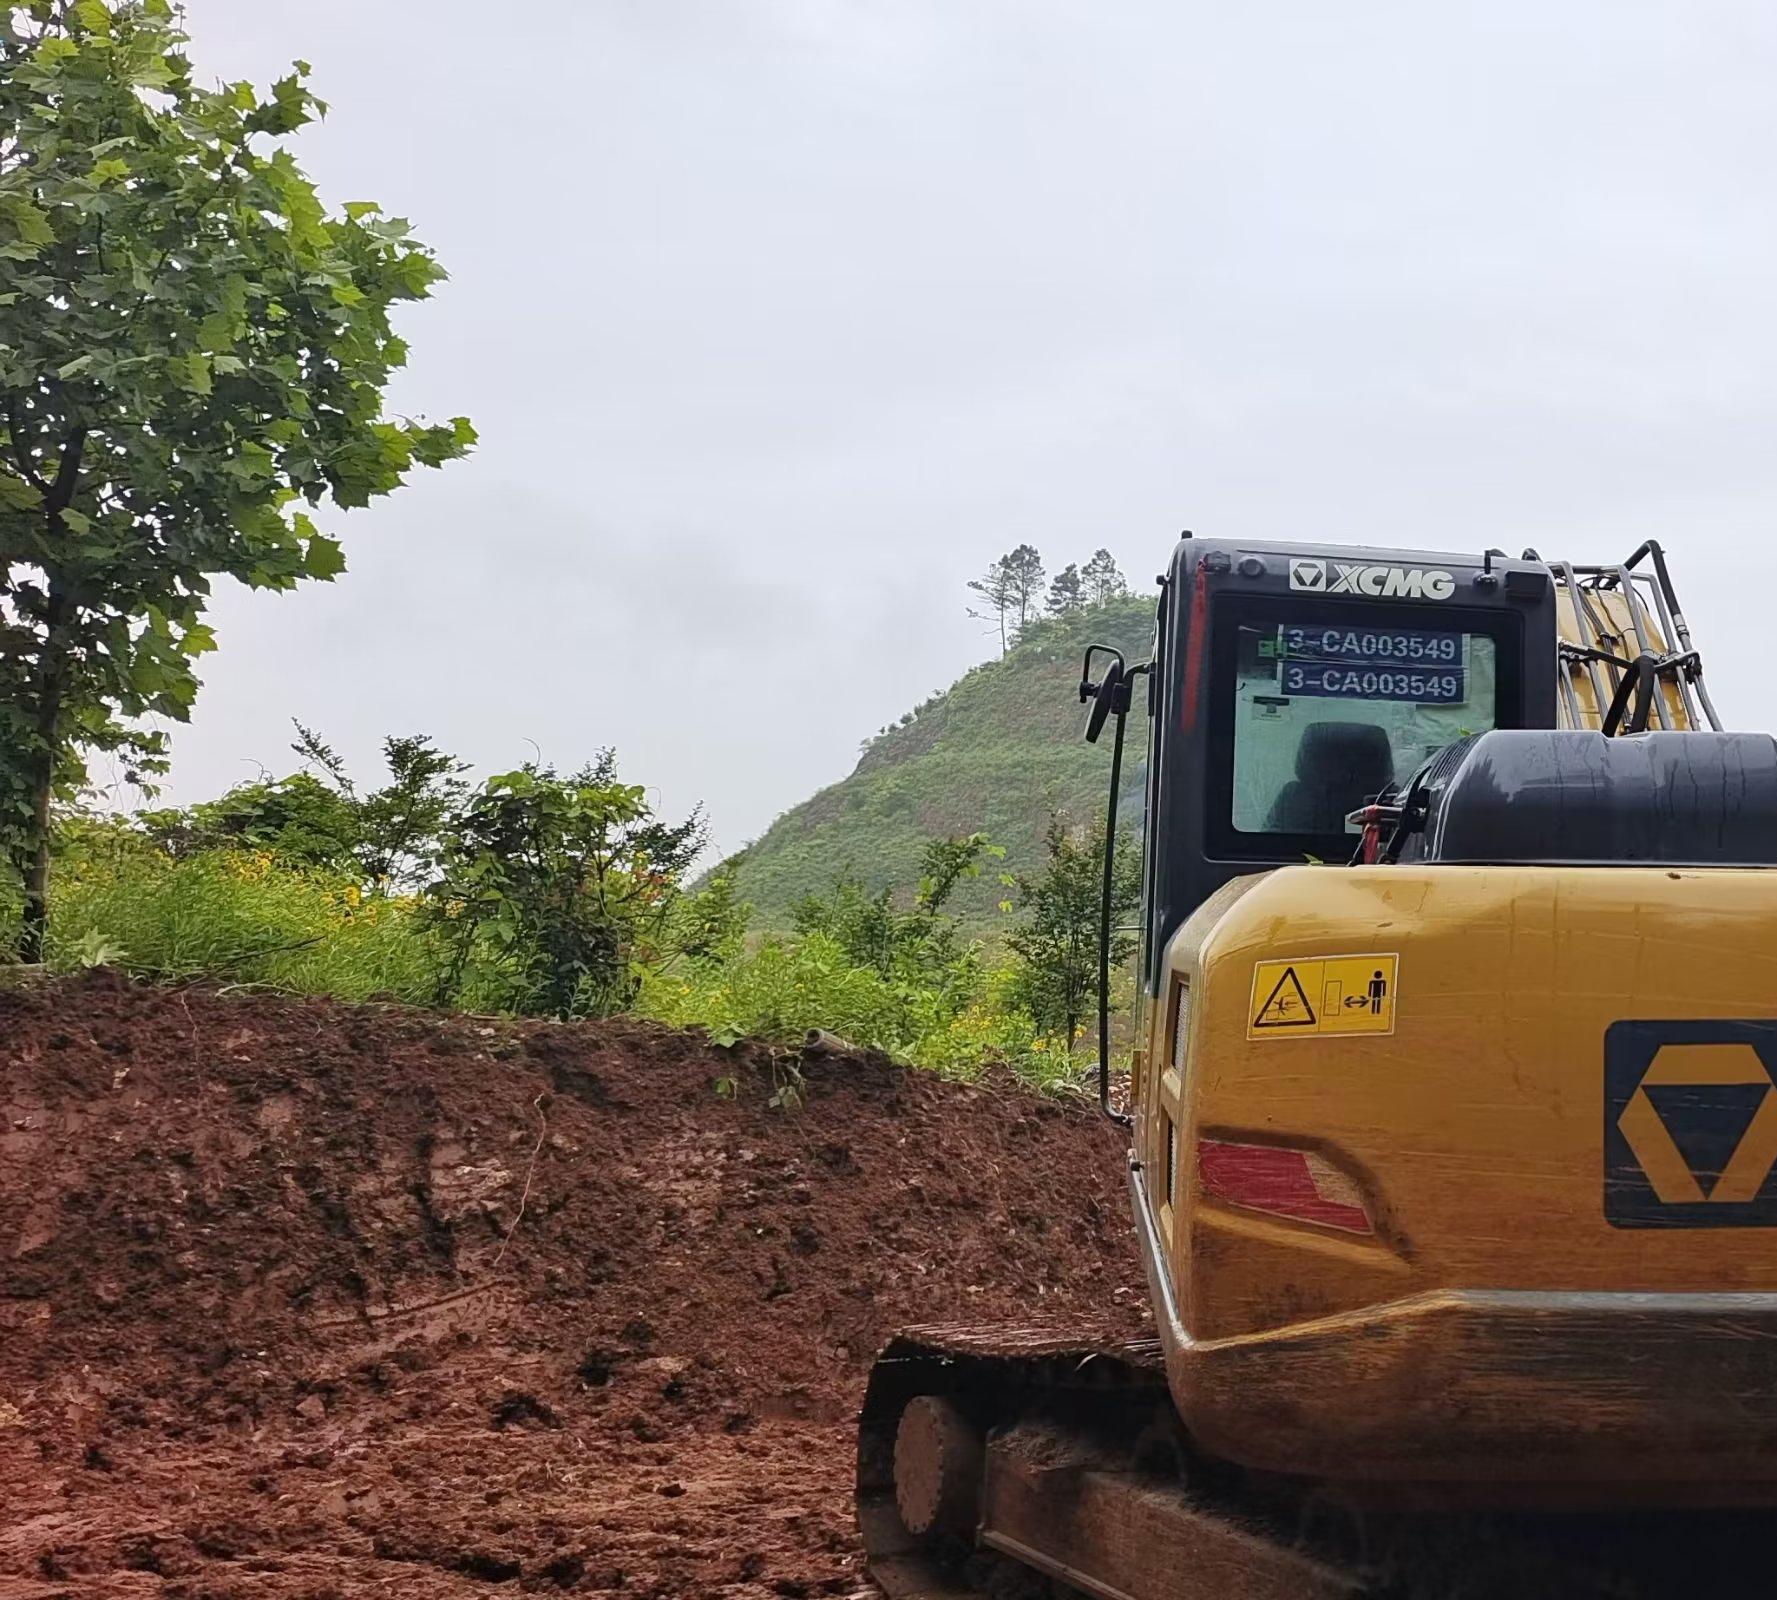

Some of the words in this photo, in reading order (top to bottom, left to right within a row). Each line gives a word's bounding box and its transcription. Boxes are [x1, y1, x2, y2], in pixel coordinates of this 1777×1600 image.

[1326, 564, 1456, 600] XCMG
[1288, 629, 1456, 660] 3-CA003549
[1287, 667, 1457, 697] 3-CA003549
